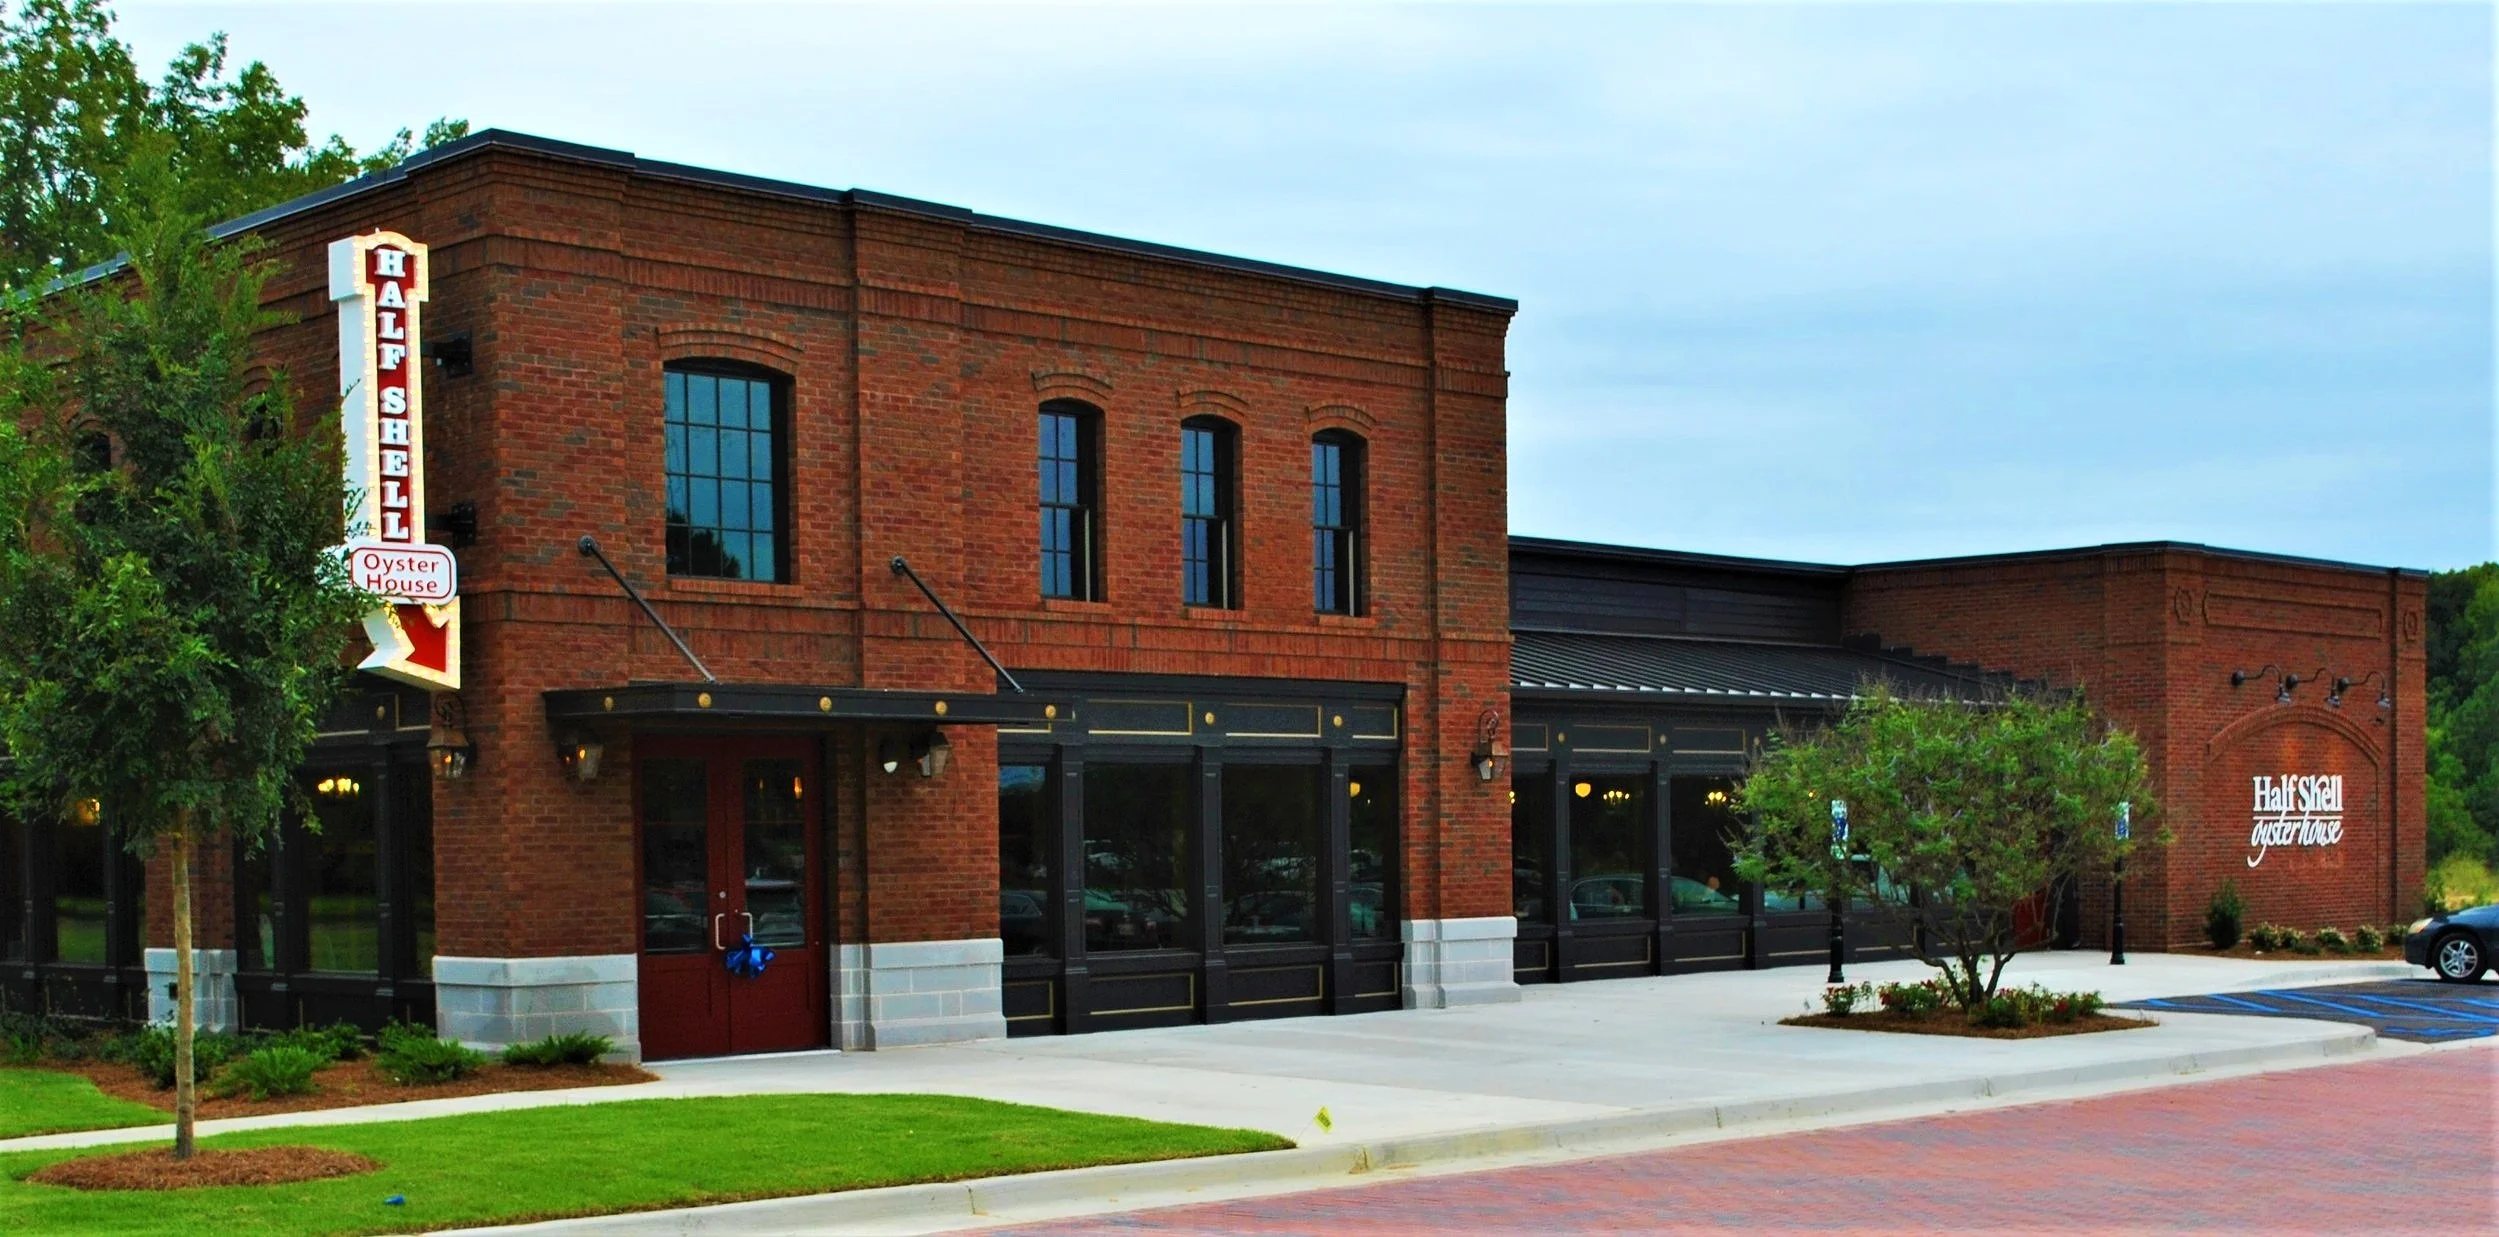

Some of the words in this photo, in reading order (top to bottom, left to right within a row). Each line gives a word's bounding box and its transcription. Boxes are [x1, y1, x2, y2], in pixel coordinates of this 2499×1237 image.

[374, 248, 407, 370] HALF
[379, 386, 410, 540] SHELL
[363, 553, 439, 576] Oyster
[366, 574, 438, 593] House
[2252, 773, 2298, 811] Half
[2298, 774, 2344, 811] Shell
